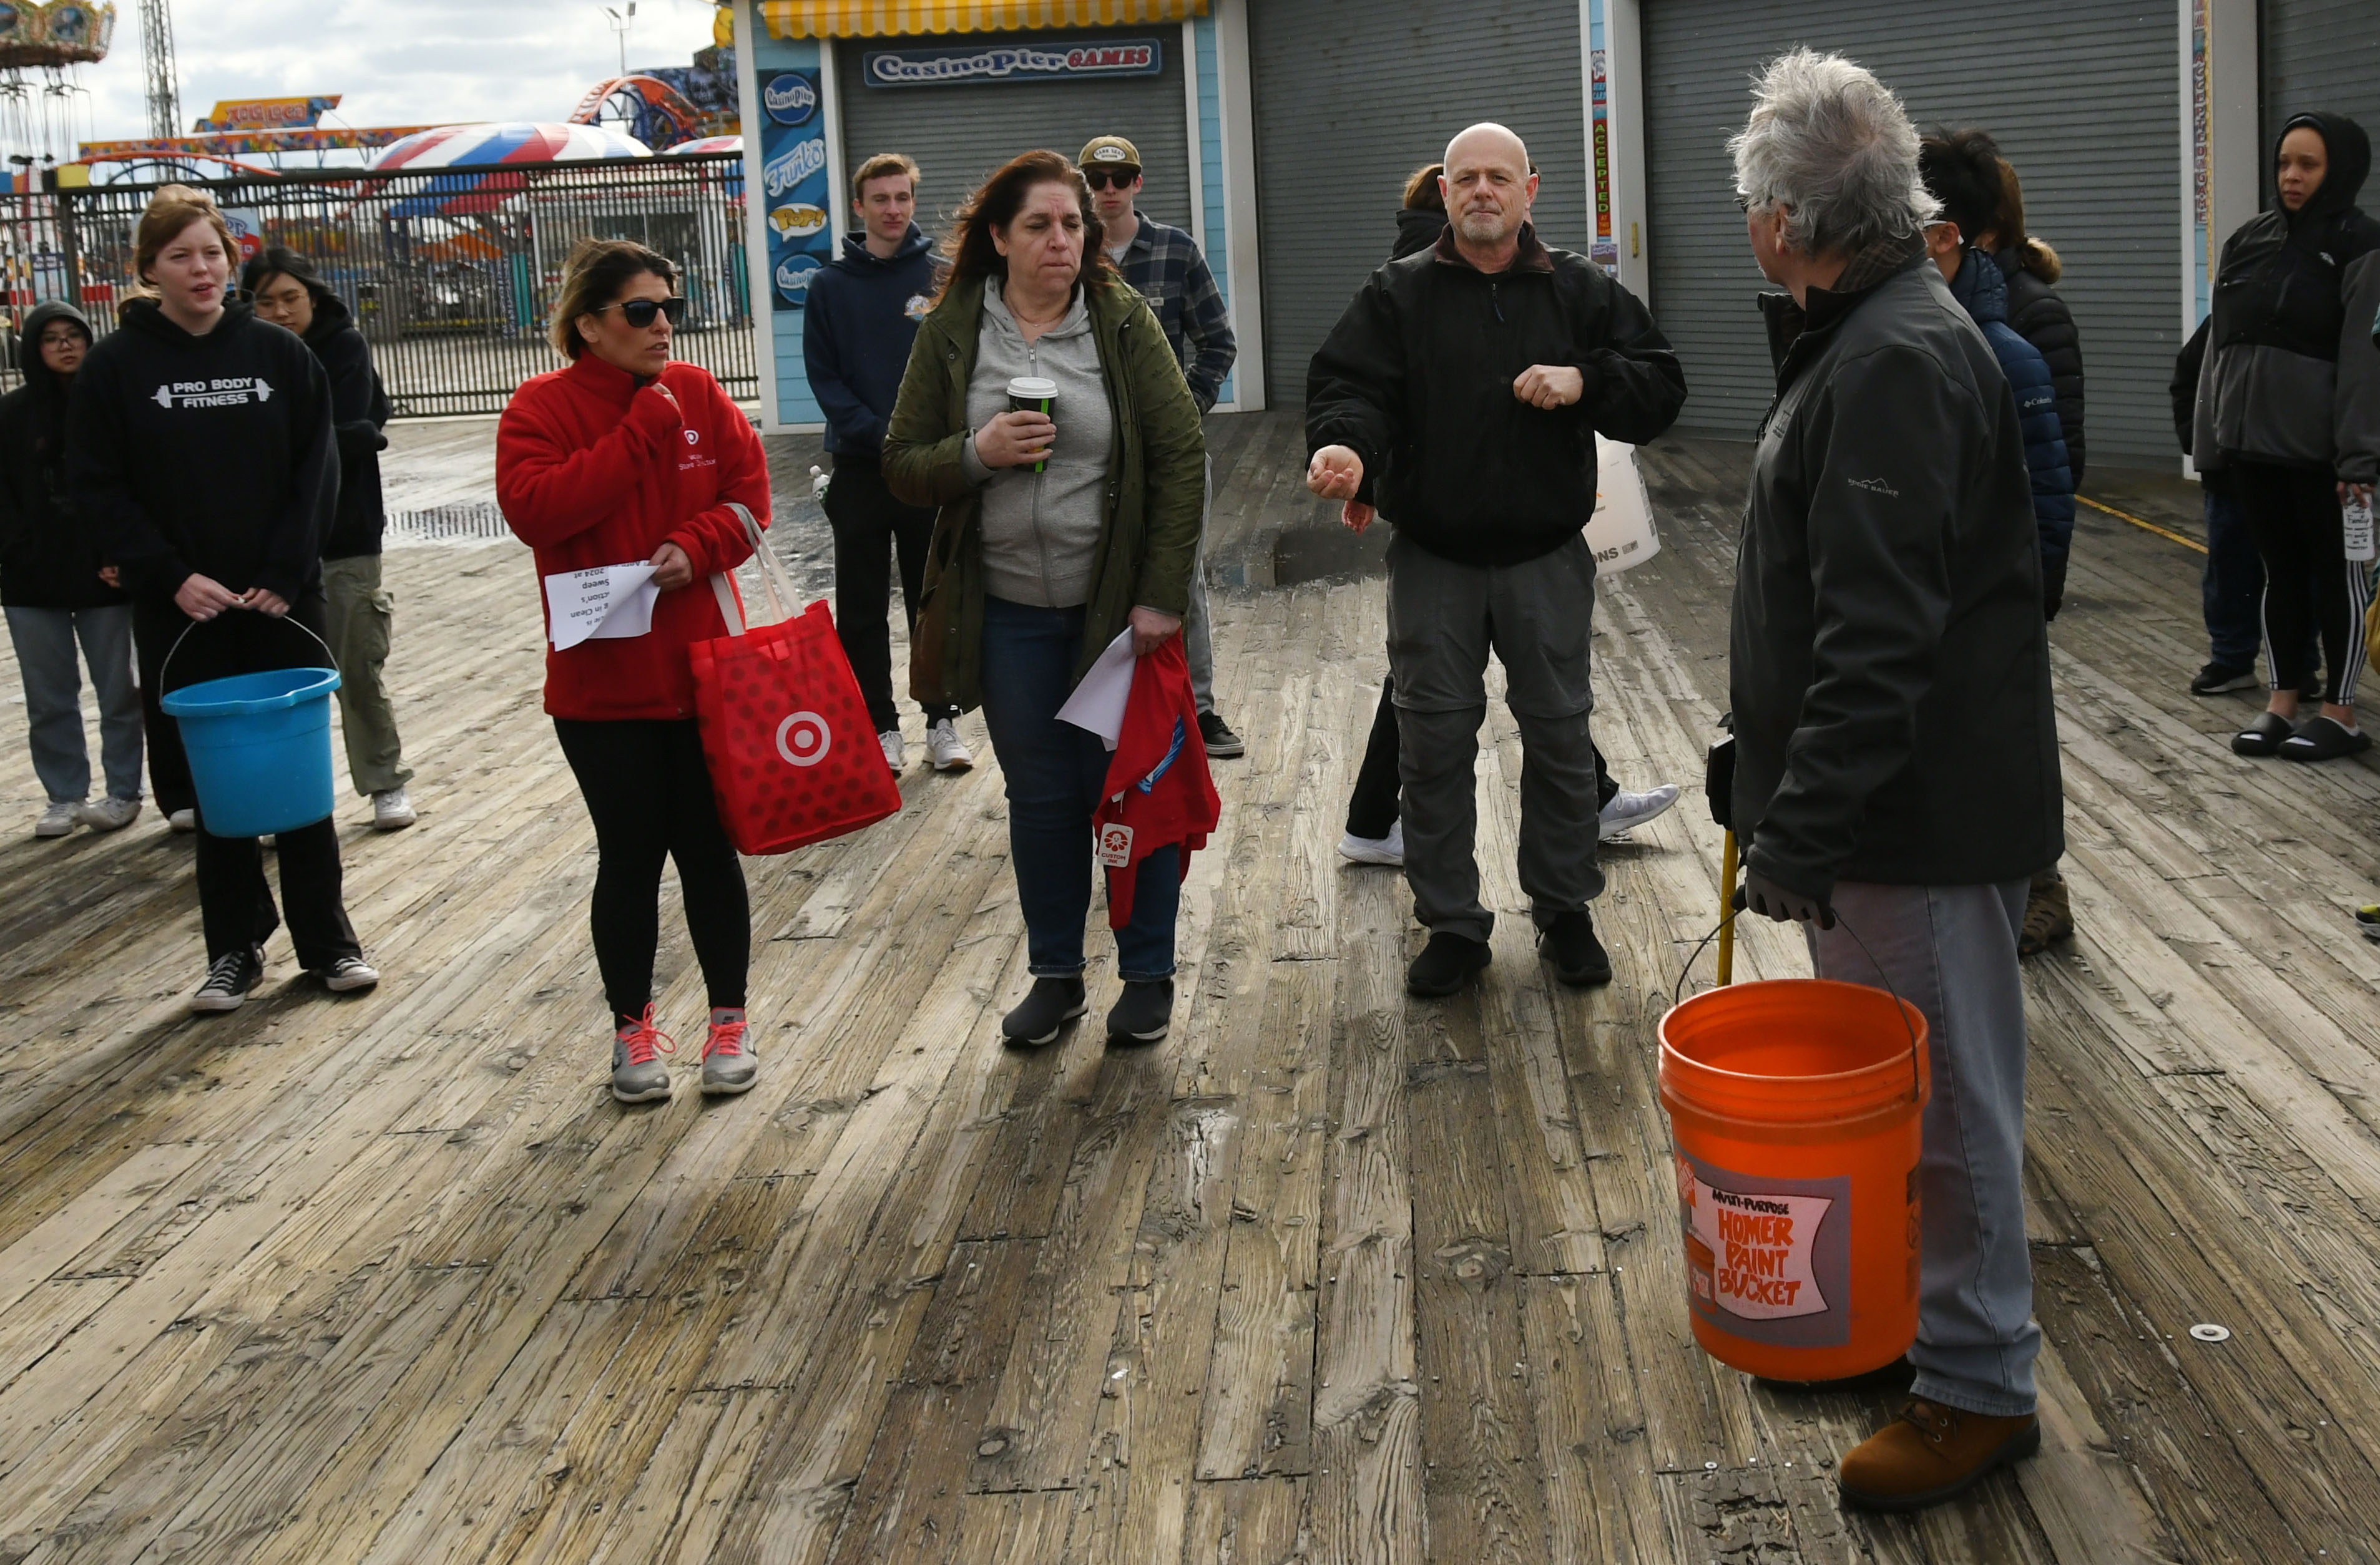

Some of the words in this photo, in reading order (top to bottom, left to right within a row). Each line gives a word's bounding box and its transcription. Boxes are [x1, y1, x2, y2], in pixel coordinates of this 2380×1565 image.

[1067, 47, 1150, 68] GAMES
[765, 139, 823, 195] Funko
[1594, 124, 1609, 213] ACCEPTED
[172, 381, 207, 393] PRO
[210, 377, 253, 390] BODY
[182, 392, 249, 408] FITNESS
[1848, 477, 1868, 489] EDDIE
[1871, 485, 1899, 499] BAUER
[574, 571, 581, 579] at
[585, 568, 605, 577] 2024
[582, 578, 610, 590] Sweep
[571, 608, 593, 618] Clean
[594, 605, 602, 613] in
[1101, 852, 1126, 861] CUSTOM
[1712, 1189, 1790, 1215] MULTI-PURPOSE
[1718, 1208, 1794, 1247] HOMER
[1725, 1239, 1789, 1278] PAINT
[1718, 1268, 1801, 1306] BUCKET
